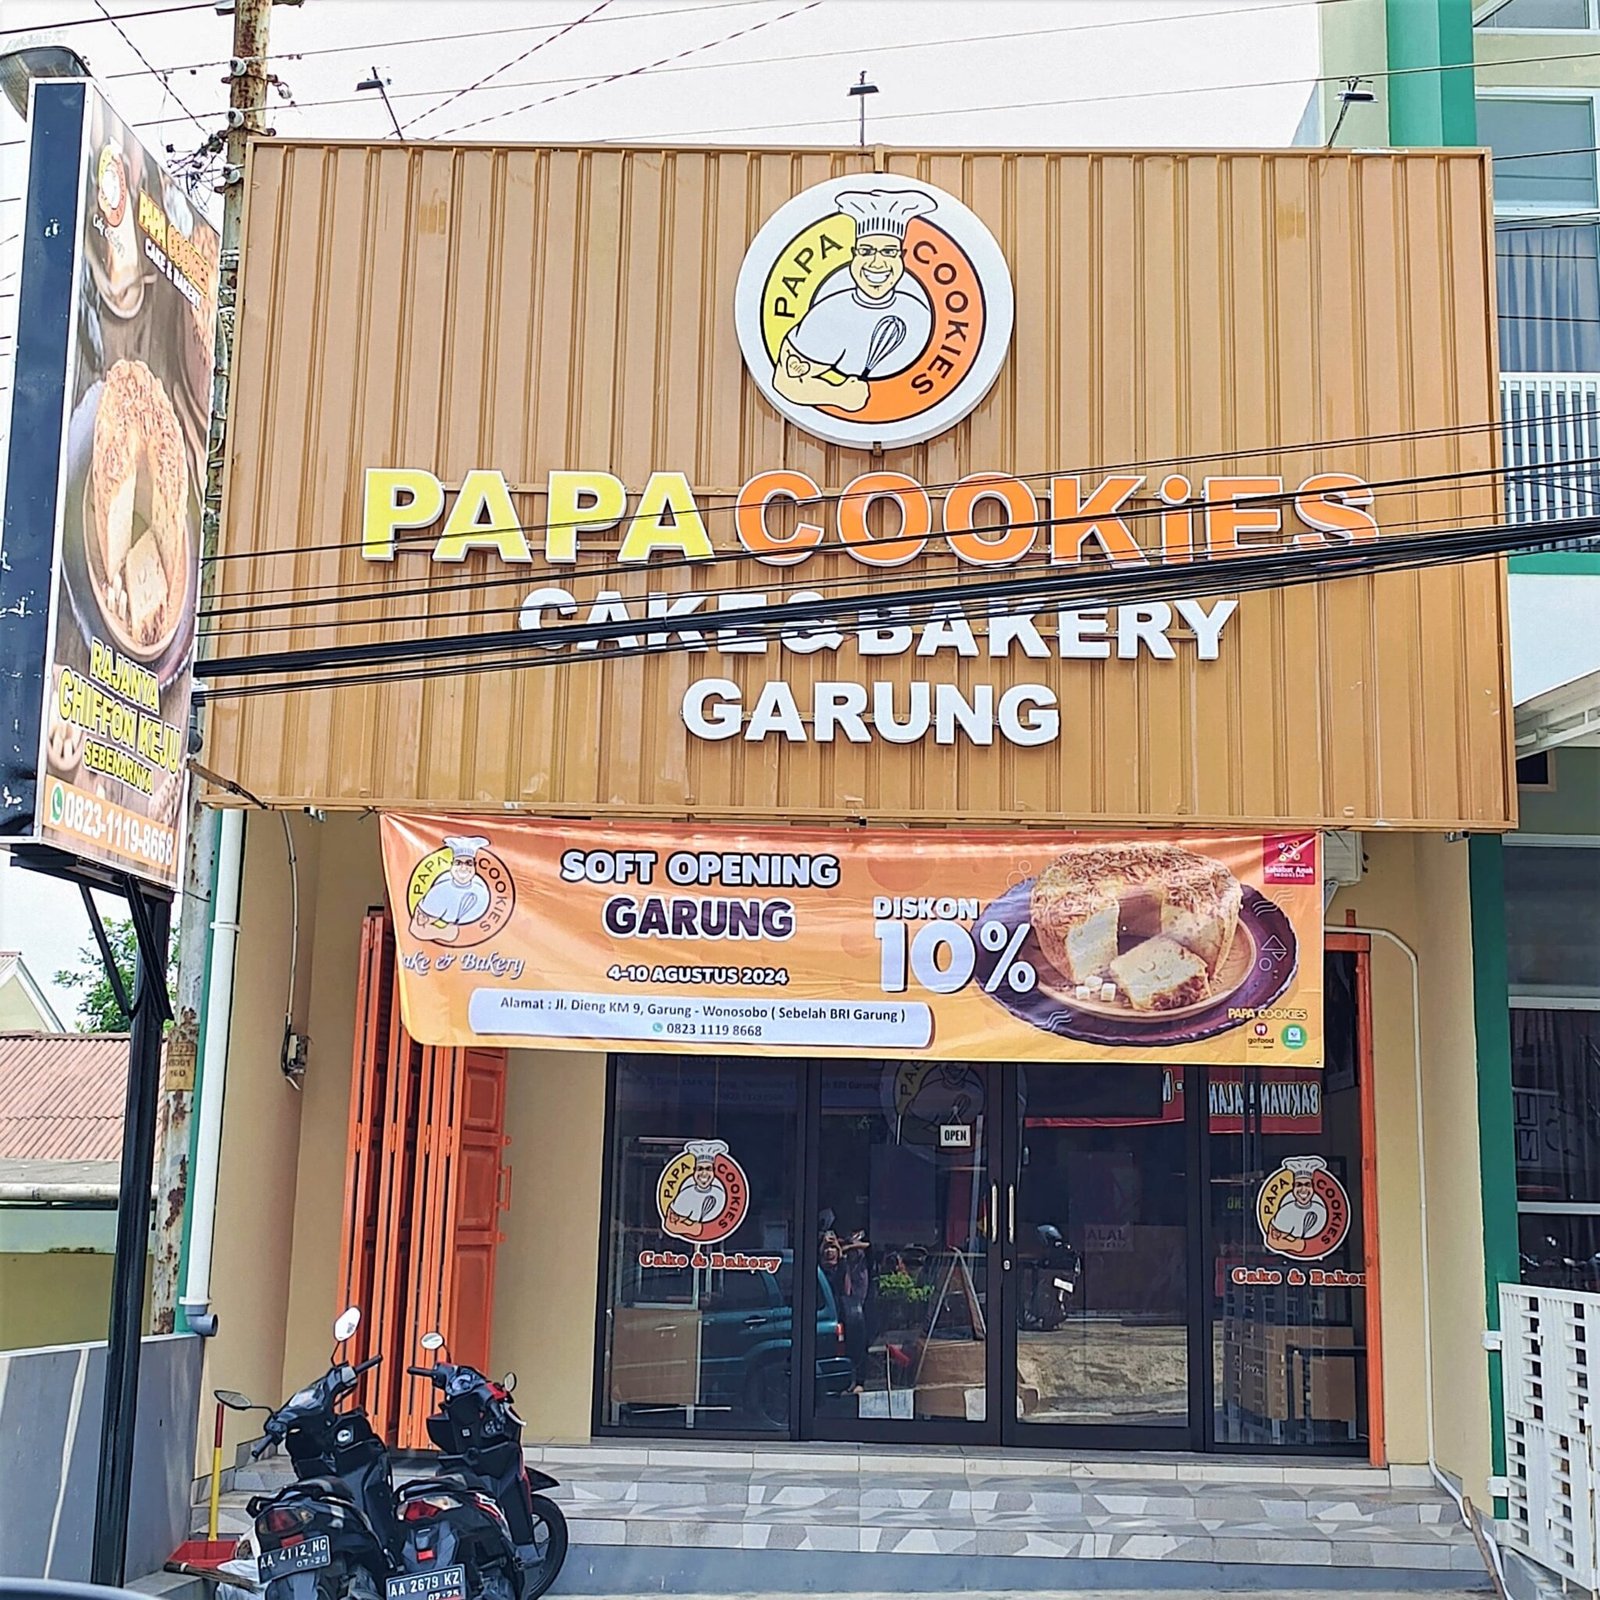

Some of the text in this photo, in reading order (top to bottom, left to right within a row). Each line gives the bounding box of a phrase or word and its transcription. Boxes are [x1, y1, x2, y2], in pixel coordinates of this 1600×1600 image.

[774, 233, 969, 395] PAPA COOKIES
[361, 467, 716, 565] PAPA
[90, 635, 161, 716] RAJANYA
[57, 667, 183, 775] CHIFFON KEJU
[682, 678, 1060, 747] GARUNG
[83, 737, 154, 799] SEBENARNYA
[64, 791, 174, 866] 0823-1119-8668
[561, 849, 841, 888] SOFT OPENING
[413, 856, 508, 932] PAPA COOKIES
[873, 896, 980, 921] DISKON
[603, 894, 796, 941] GARUNG
[402, 951, 431, 975] ake
[461, 951, 526, 979] Bakery
[607, 965, 790, 986] 4-10 AGUSTUS 2024
[874, 919, 1036, 994] 10%
[500, 997, 544, 1011] Alamat
[571, 999, 606, 1014] Dieng
[609, 1002, 629, 1014] KM
[633, 1003, 644, 1016] 9,
[647, 1004, 692, 1018] Garung
[702, 1005, 768, 1019] Wonosobo
[779, 1006, 827, 1020] Sebelah
[829, 1008, 850, 1020] BRI
[853, 1008, 898, 1023] Garung
[666, 1022, 762, 1037] 0823 1119 8668
[1228, 1008, 1308, 1020] PAPA COOKIES
[944, 1130, 967, 1142] OPEN
[663, 1162, 741, 1229] PAPA COOKIES
[1264, 1177, 1343, 1245] PAPA COOKIES
[639, 1251, 782, 1274] Cake & Bakery
[1232, 1267, 1282, 1285] Cake
[1287, 1267, 1306, 1285] &
[260, 1554, 276, 1569] AA
[391, 1571, 460, 1598] AA 2679 KZ
